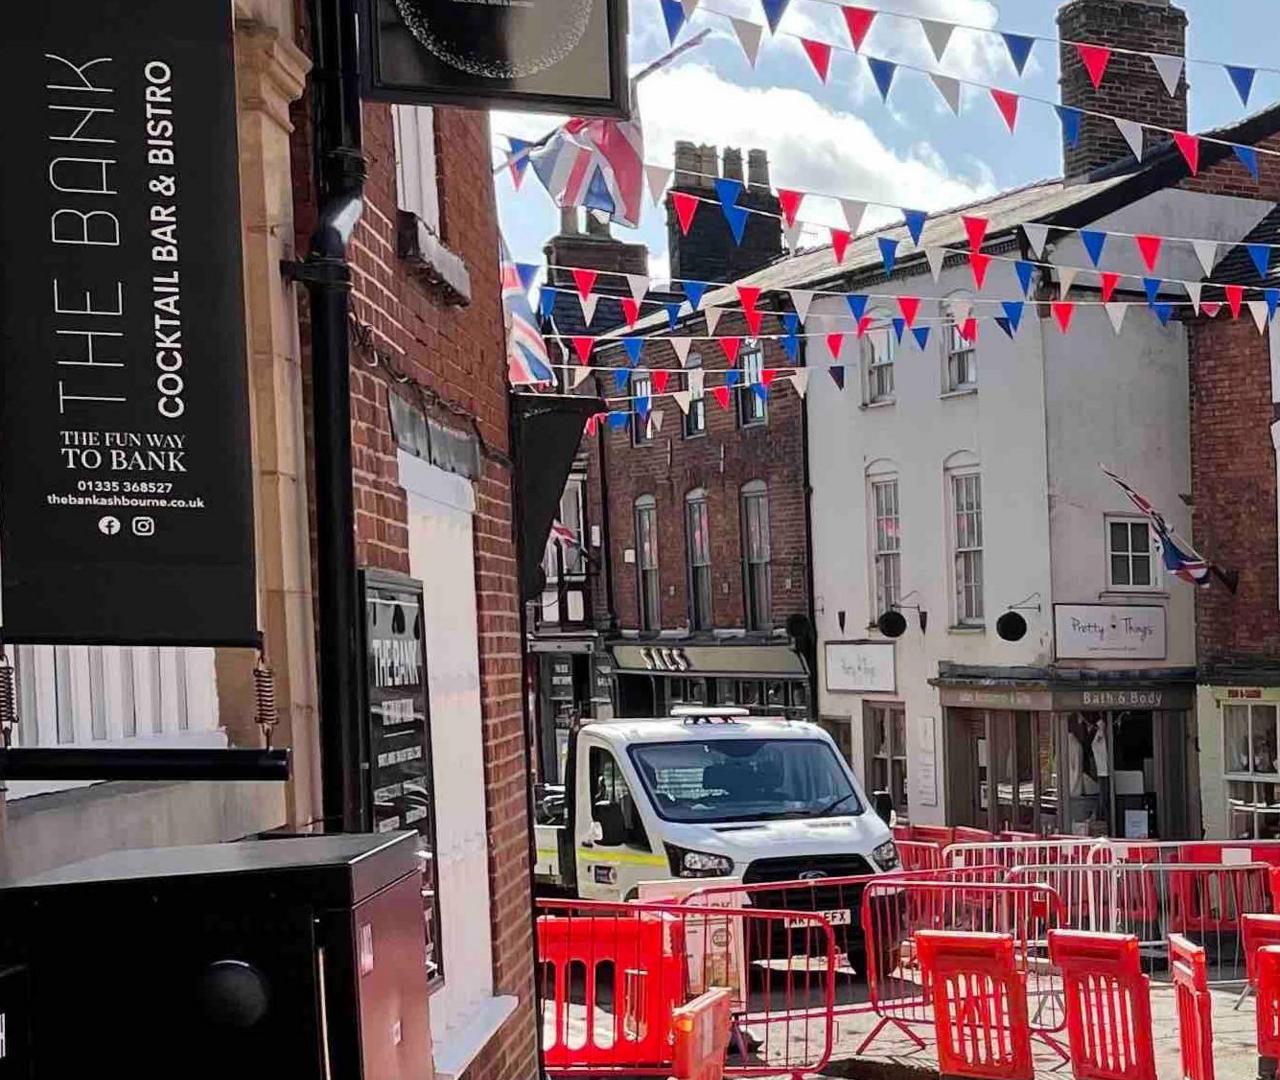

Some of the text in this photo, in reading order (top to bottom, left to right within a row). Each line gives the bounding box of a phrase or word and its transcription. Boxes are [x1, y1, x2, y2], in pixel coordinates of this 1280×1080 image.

[45, 53, 127, 414] THE BANK
[144, 60, 185, 418] COCKTAIL BAR & BISTRO
[60, 431, 186, 449] THE FUN WAY
[61, 448, 187, 472] TO BANK
[77, 480, 173, 494] 01335 368527
[47, 494, 205, 508] thebankashbourne.co.uk
[1130, 690, 1163, 706] Body
